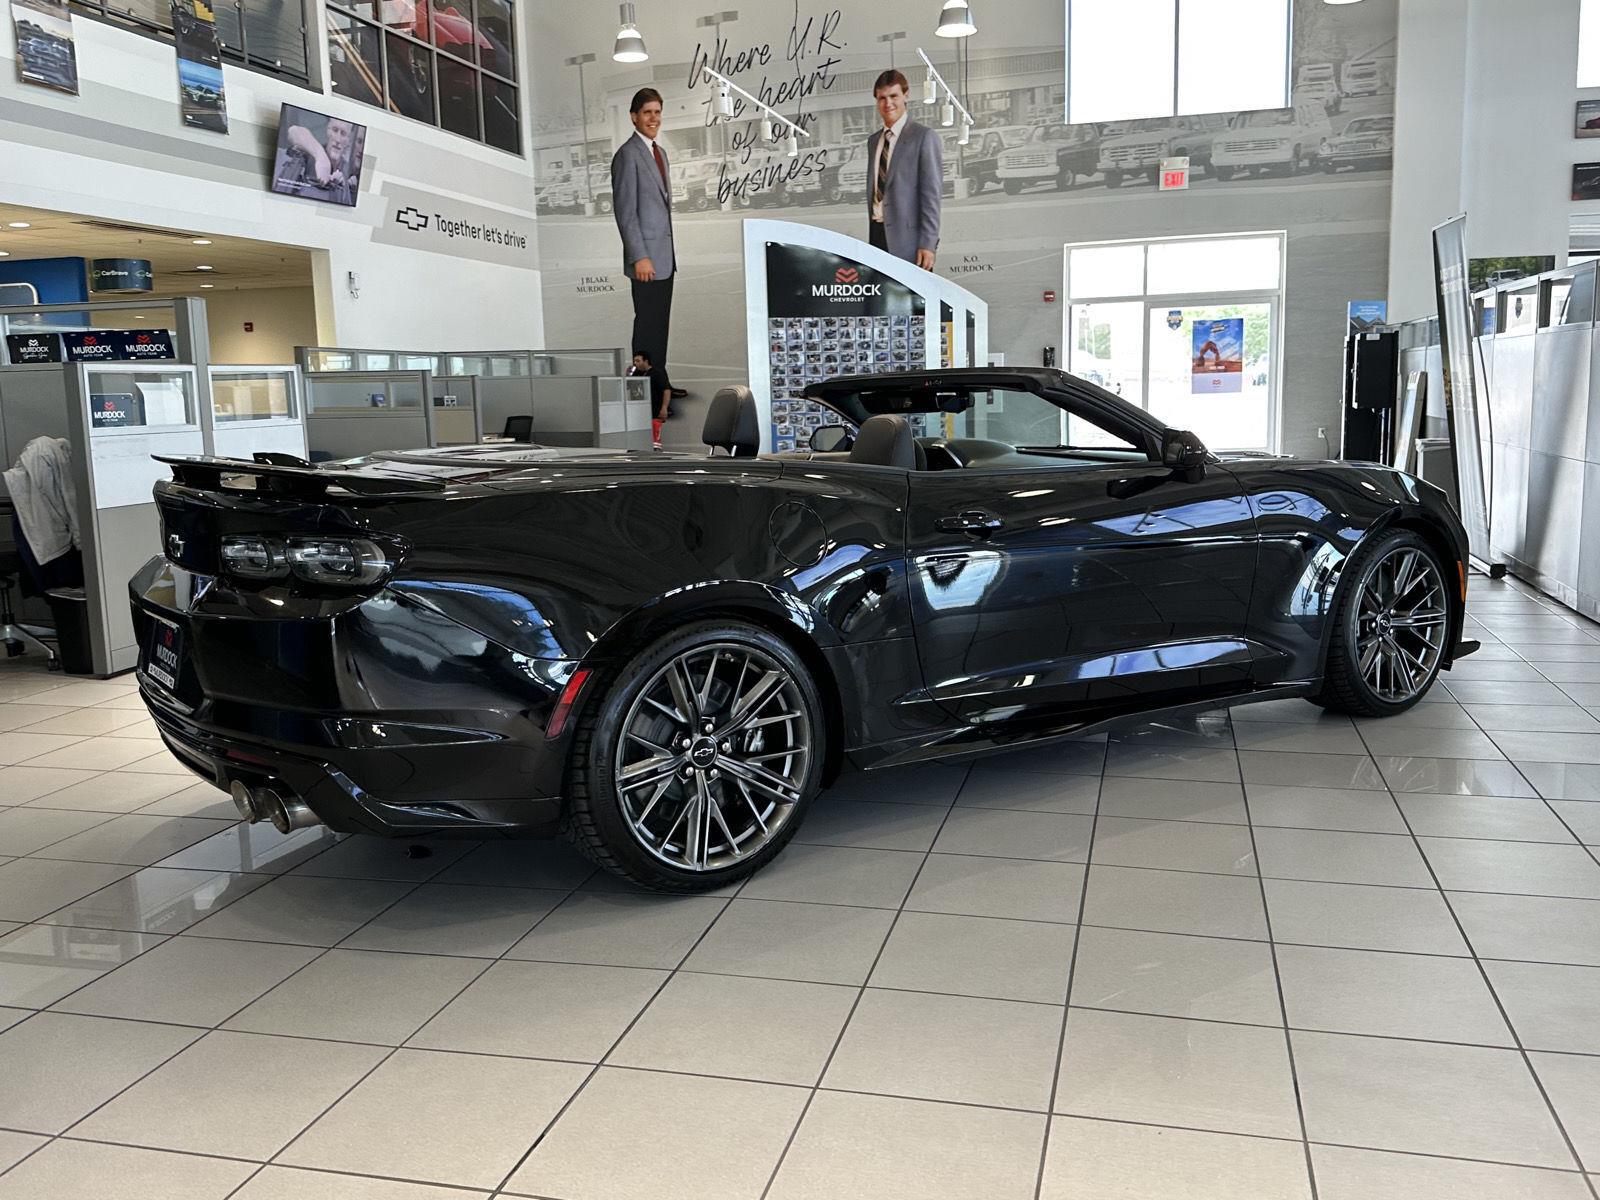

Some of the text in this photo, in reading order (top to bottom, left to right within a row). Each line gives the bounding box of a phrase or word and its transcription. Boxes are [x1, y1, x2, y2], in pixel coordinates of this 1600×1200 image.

[688, 38, 772, 90] Where
[701, 58, 842, 128] te heart
[732, 121, 757, 164] of
[717, 149, 828, 204] business
[1164, 171, 1185, 187] EXIT
[435, 213, 527, 249] Together let's drive
[963, 255, 979, 264] K.O.
[950, 263, 994, 273] MURDOCK
[586, 276, 609, 284] BLAKE
[577, 285, 615, 293] MURDOCK
[812, 284, 882, 297] MURDOCK
[72, 344, 113, 355] MURDOCK
[125, 343, 167, 353] MURDOCK
[94, 410, 126, 419] MURDOCK
